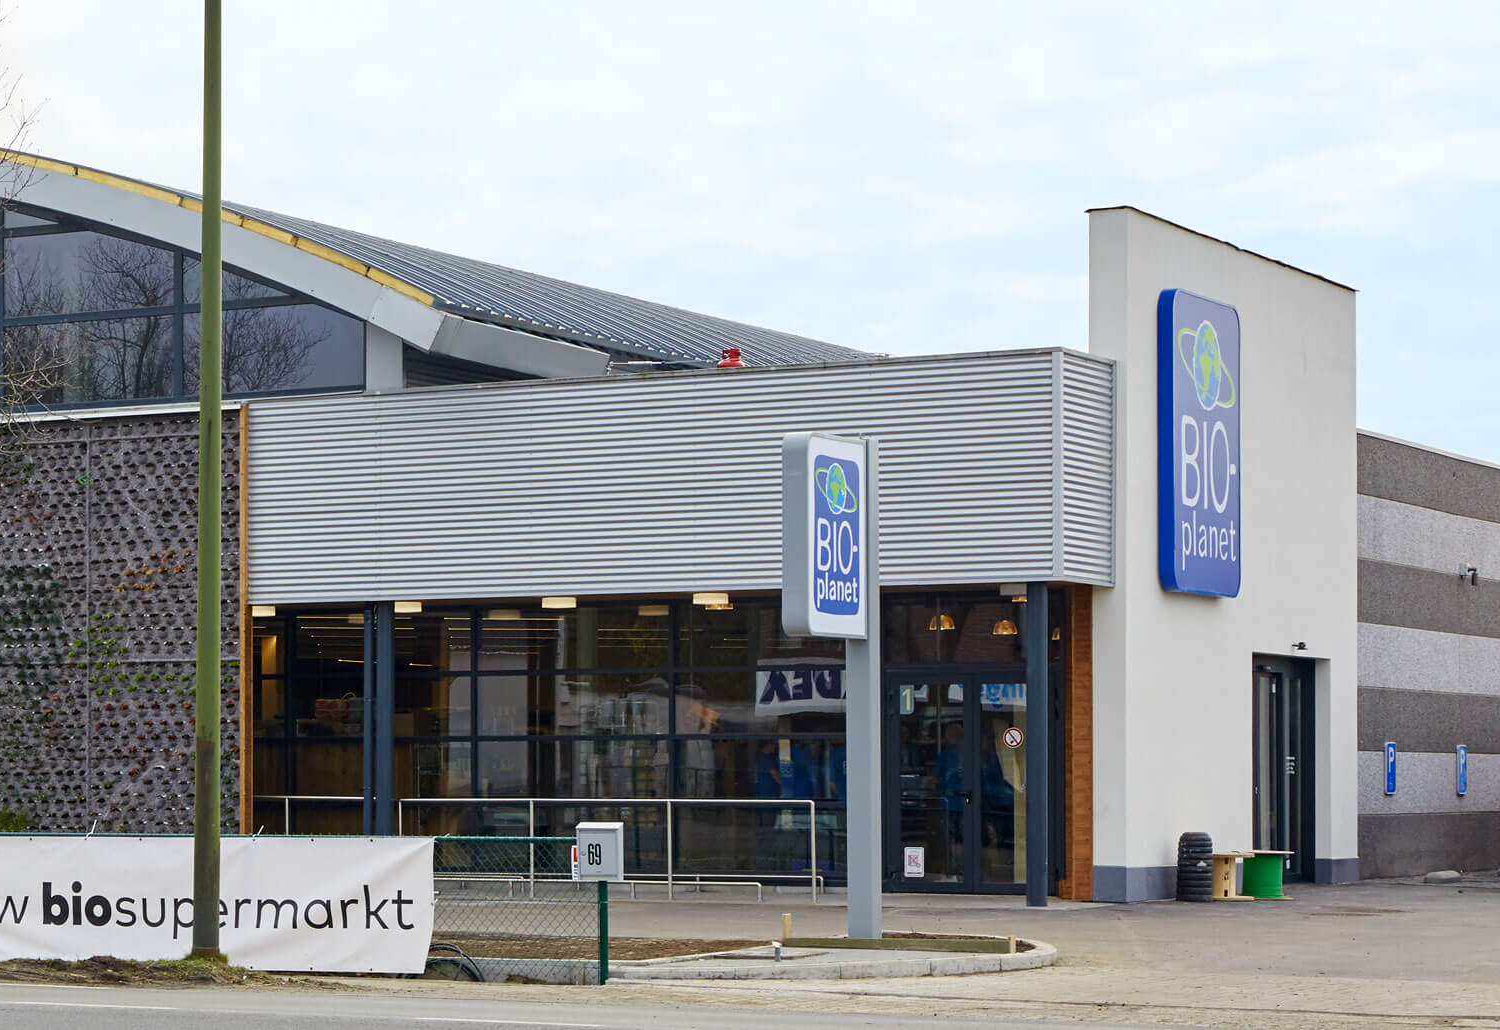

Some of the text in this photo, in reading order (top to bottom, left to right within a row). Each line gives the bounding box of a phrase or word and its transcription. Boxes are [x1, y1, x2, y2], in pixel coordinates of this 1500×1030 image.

[1181, 415, 1236, 514] BIO-
[817, 518, 858, 575] BIO-
[1181, 510, 1236, 571] planet
[817, 572, 858, 608] planet
[902, 689, 911, 711] 1
[588, 844, 602, 866] 69
